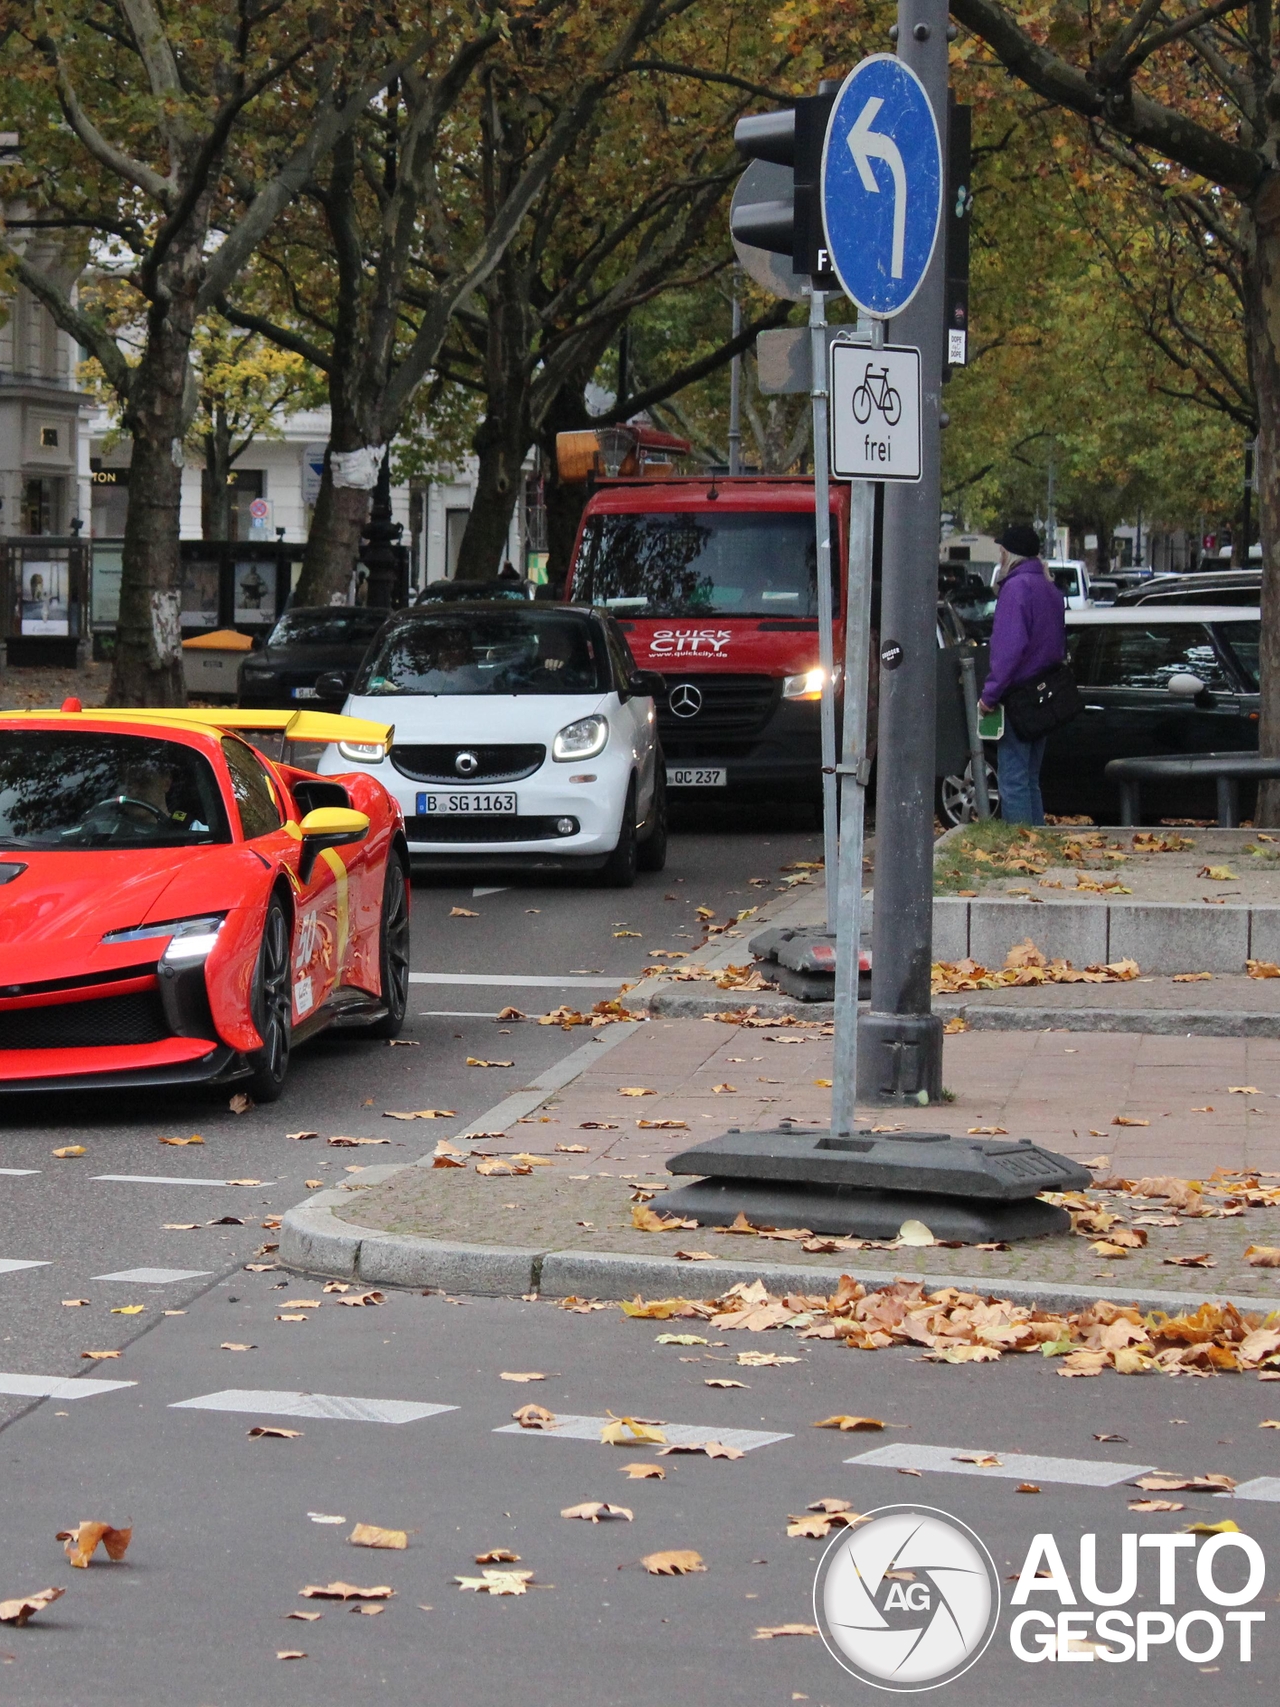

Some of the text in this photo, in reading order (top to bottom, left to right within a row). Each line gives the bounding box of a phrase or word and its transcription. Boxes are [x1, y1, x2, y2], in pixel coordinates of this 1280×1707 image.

[864, 434, 891, 462] frei
[653, 630, 732, 638] QUICK
[650, 638, 731, 652] CITY
[648, 650, 728, 658] www.quickcity.de
[675, 771, 720, 784] QC 237
[427, 796, 513, 811] B SG 1163
